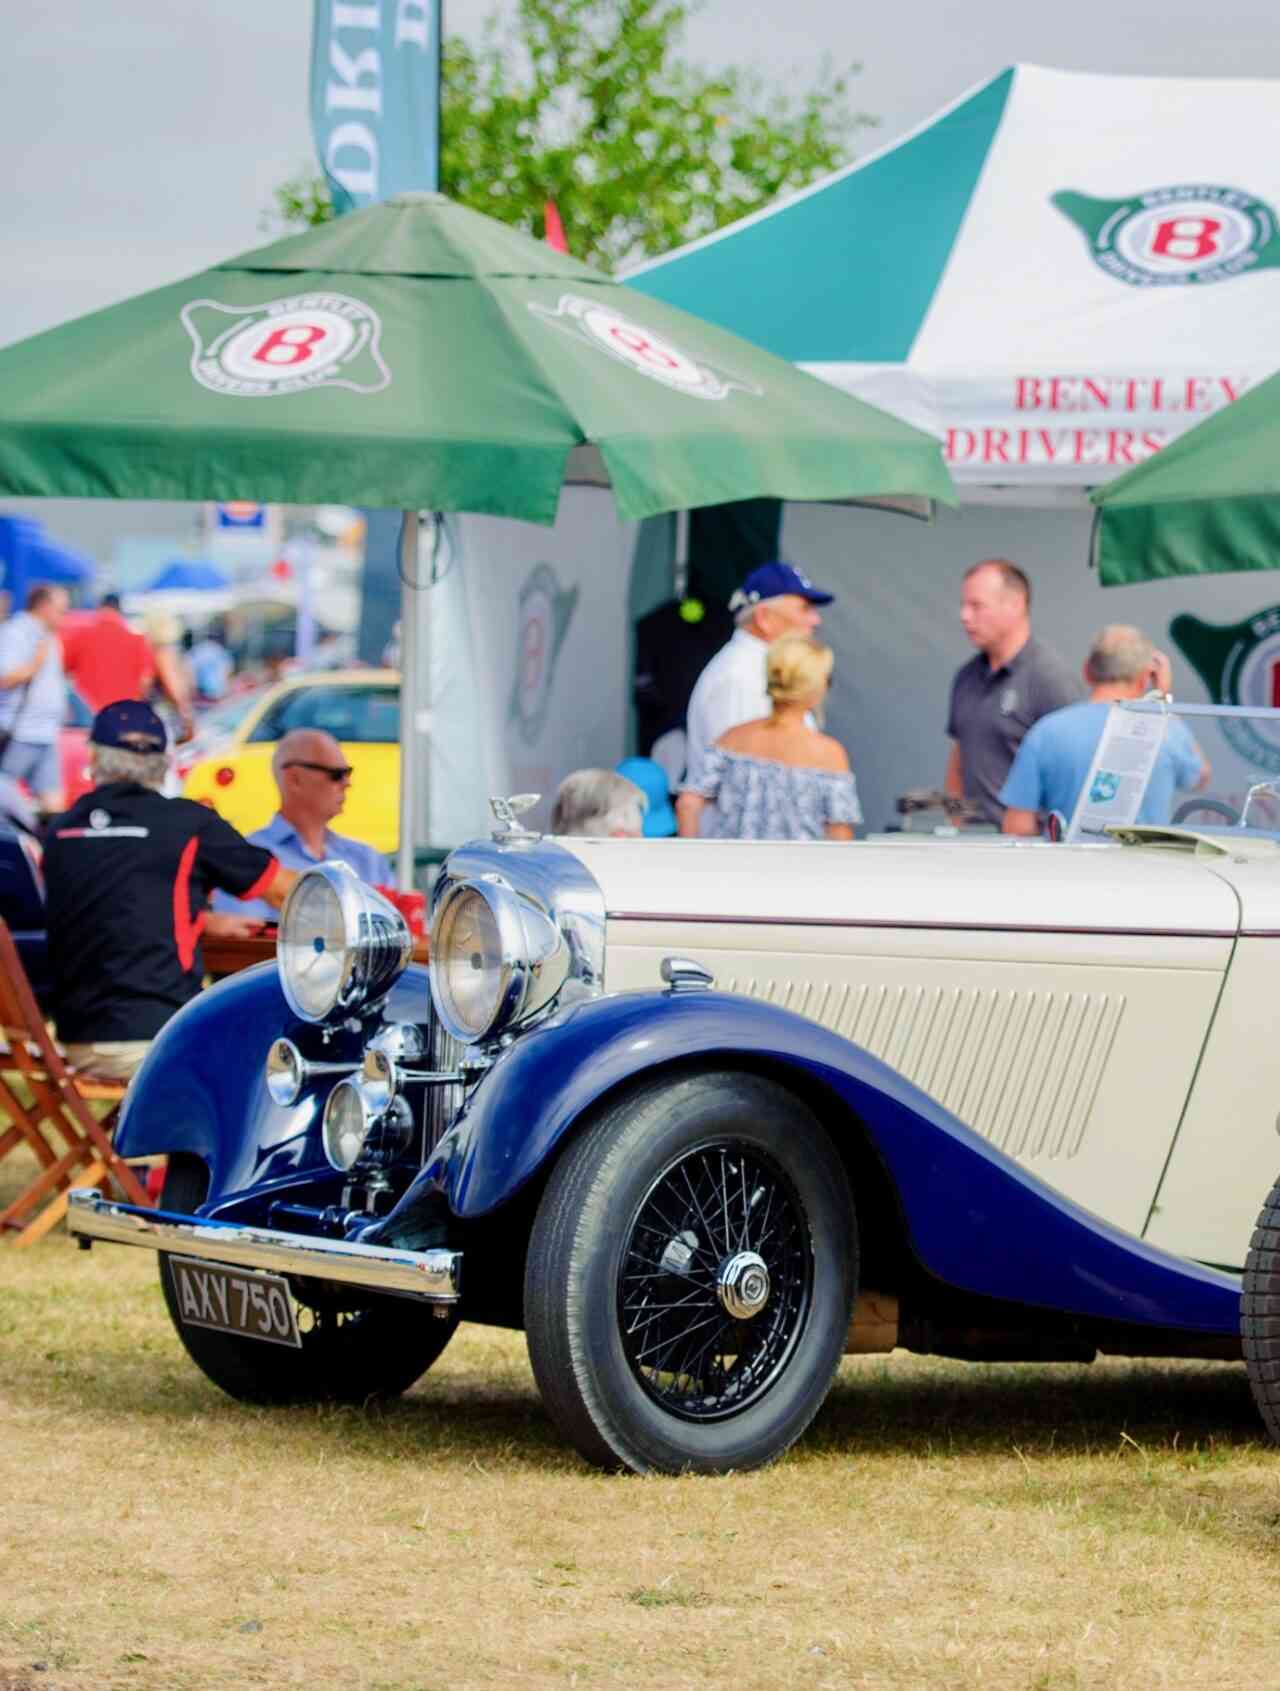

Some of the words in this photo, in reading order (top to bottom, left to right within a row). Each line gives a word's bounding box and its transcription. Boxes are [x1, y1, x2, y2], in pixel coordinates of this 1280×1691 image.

[1152, 216, 1221, 261] B
[252, 325, 326, 365] B
[1013, 376, 1249, 412] BENTLEY
[944, 427, 1167, 464] DRIVERS
